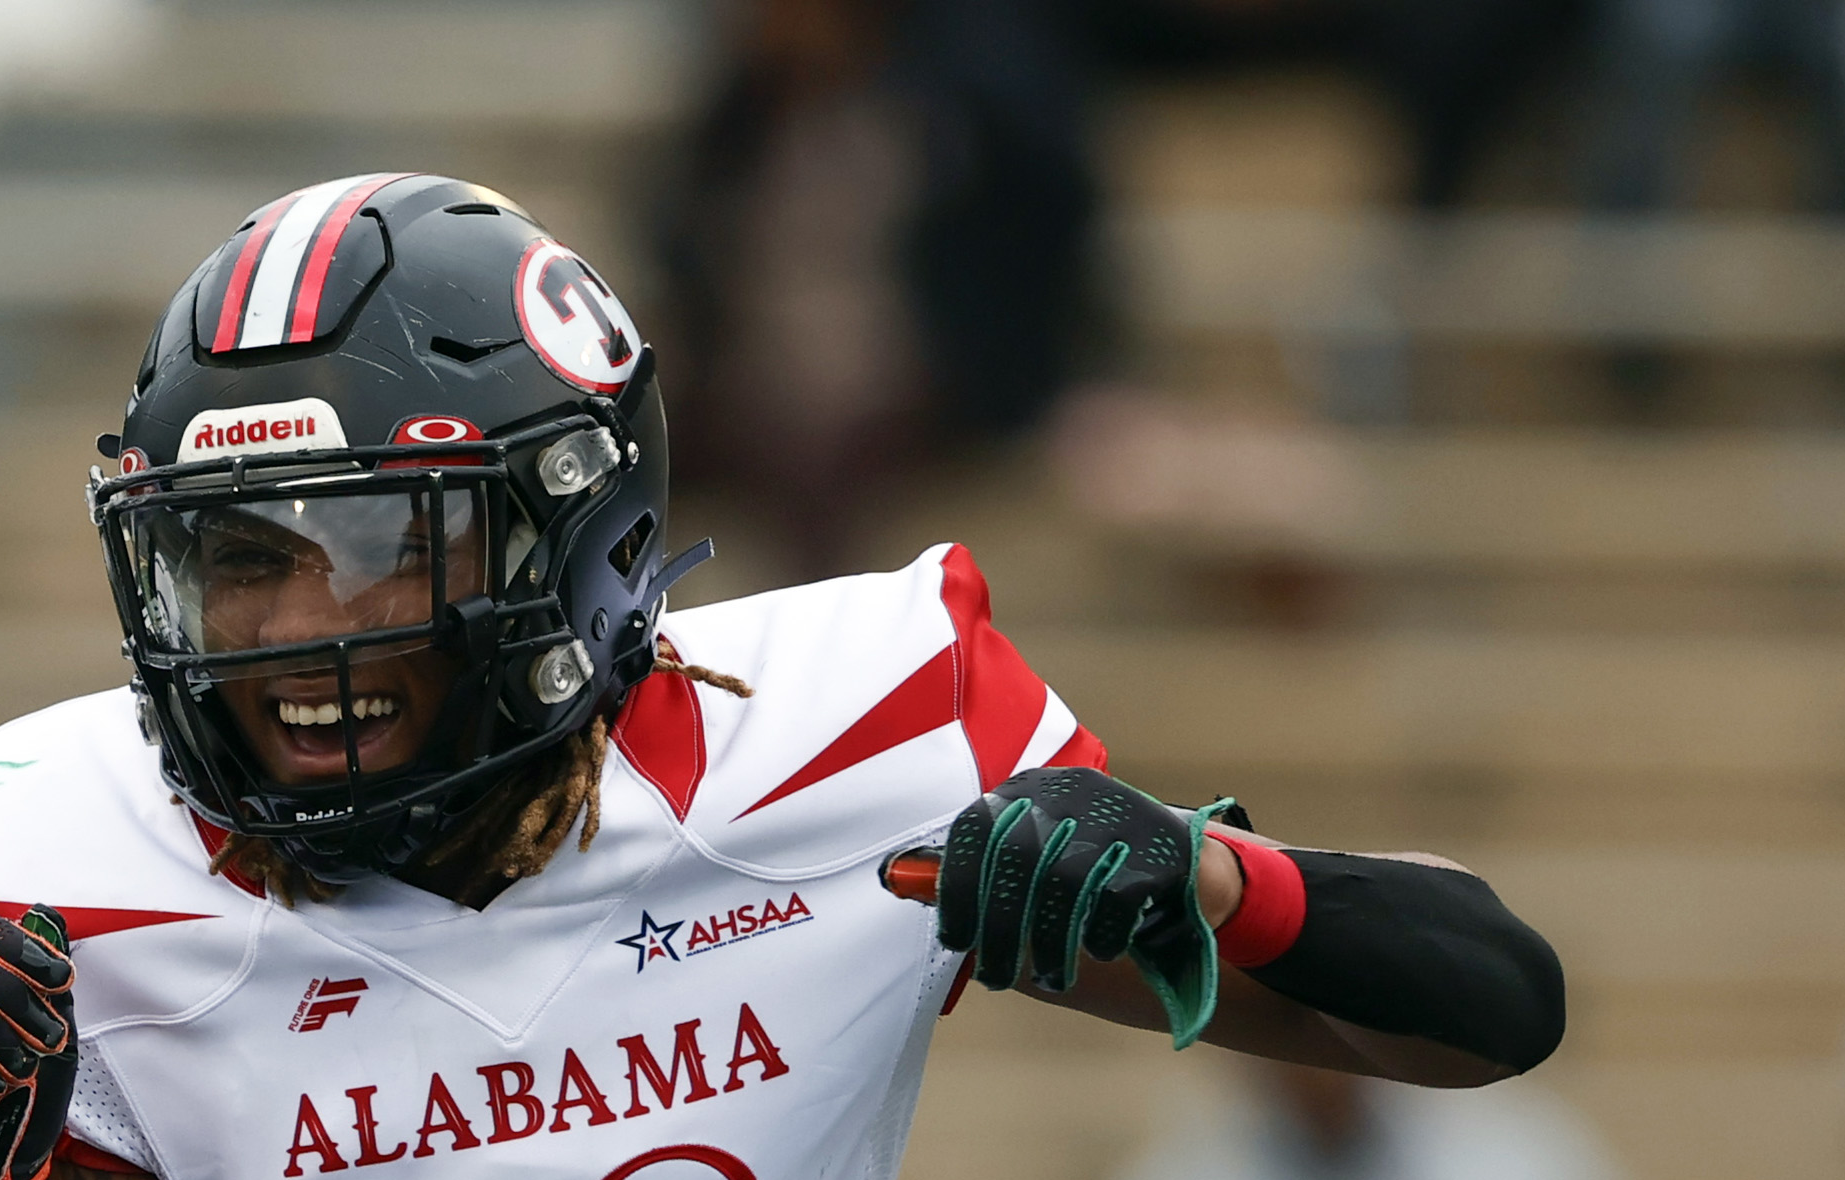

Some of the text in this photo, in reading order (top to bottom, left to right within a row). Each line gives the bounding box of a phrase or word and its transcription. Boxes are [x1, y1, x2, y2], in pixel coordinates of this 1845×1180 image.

[194, 416, 315, 449] Riddell
[686, 892, 811, 951] AHSAA
[284, 1003, 789, 1177] ALABAMA
